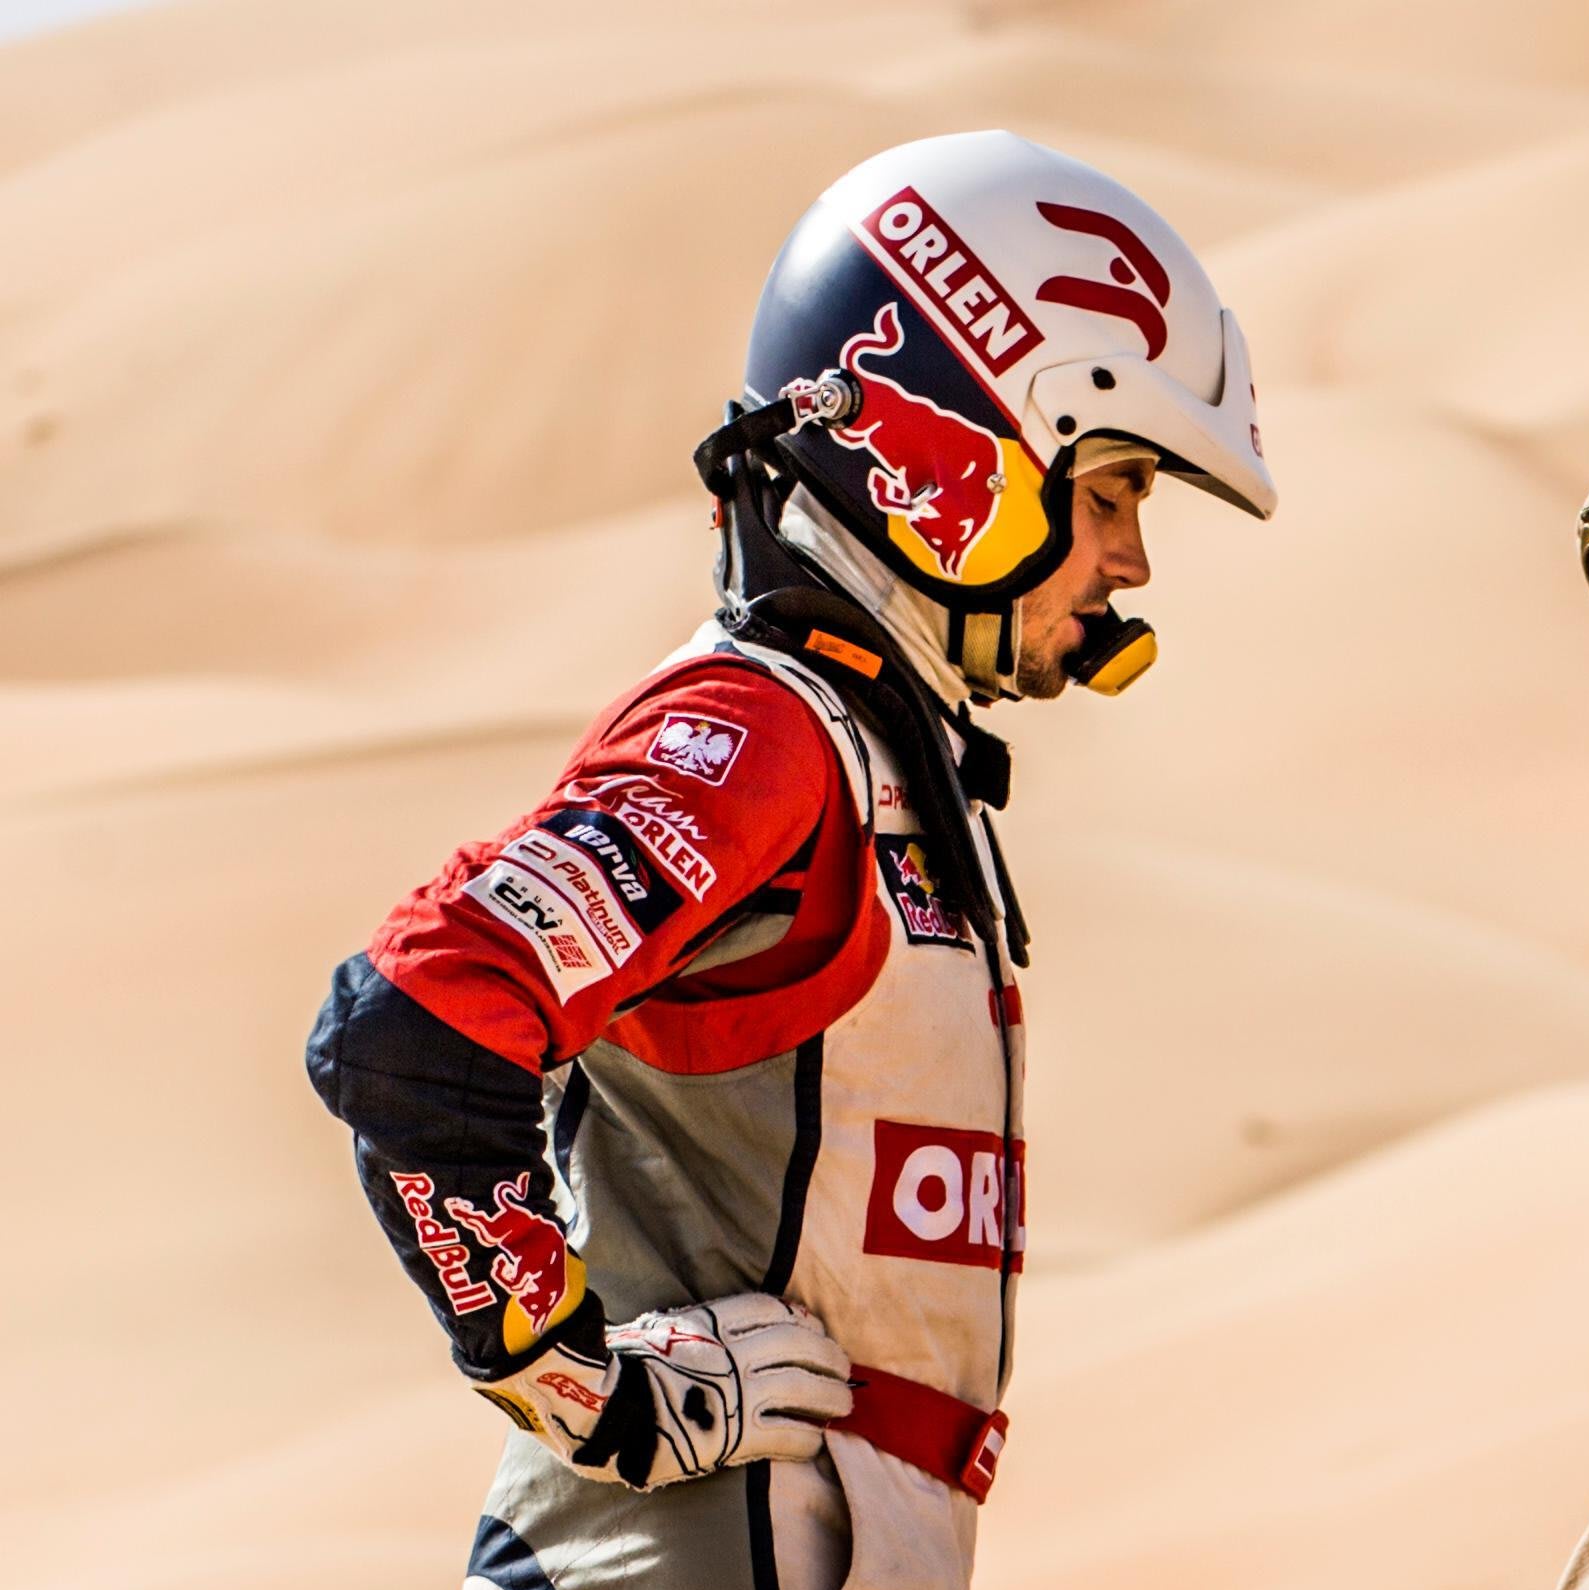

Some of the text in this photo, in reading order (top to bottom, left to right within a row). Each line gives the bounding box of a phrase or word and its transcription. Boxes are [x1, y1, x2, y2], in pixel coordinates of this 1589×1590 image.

[878, 201, 1027, 362] ORLEN
[564, 824, 649, 902] verva
[623, 811, 711, 893] ORLEN
[553, 861, 631, 951] Platinum
